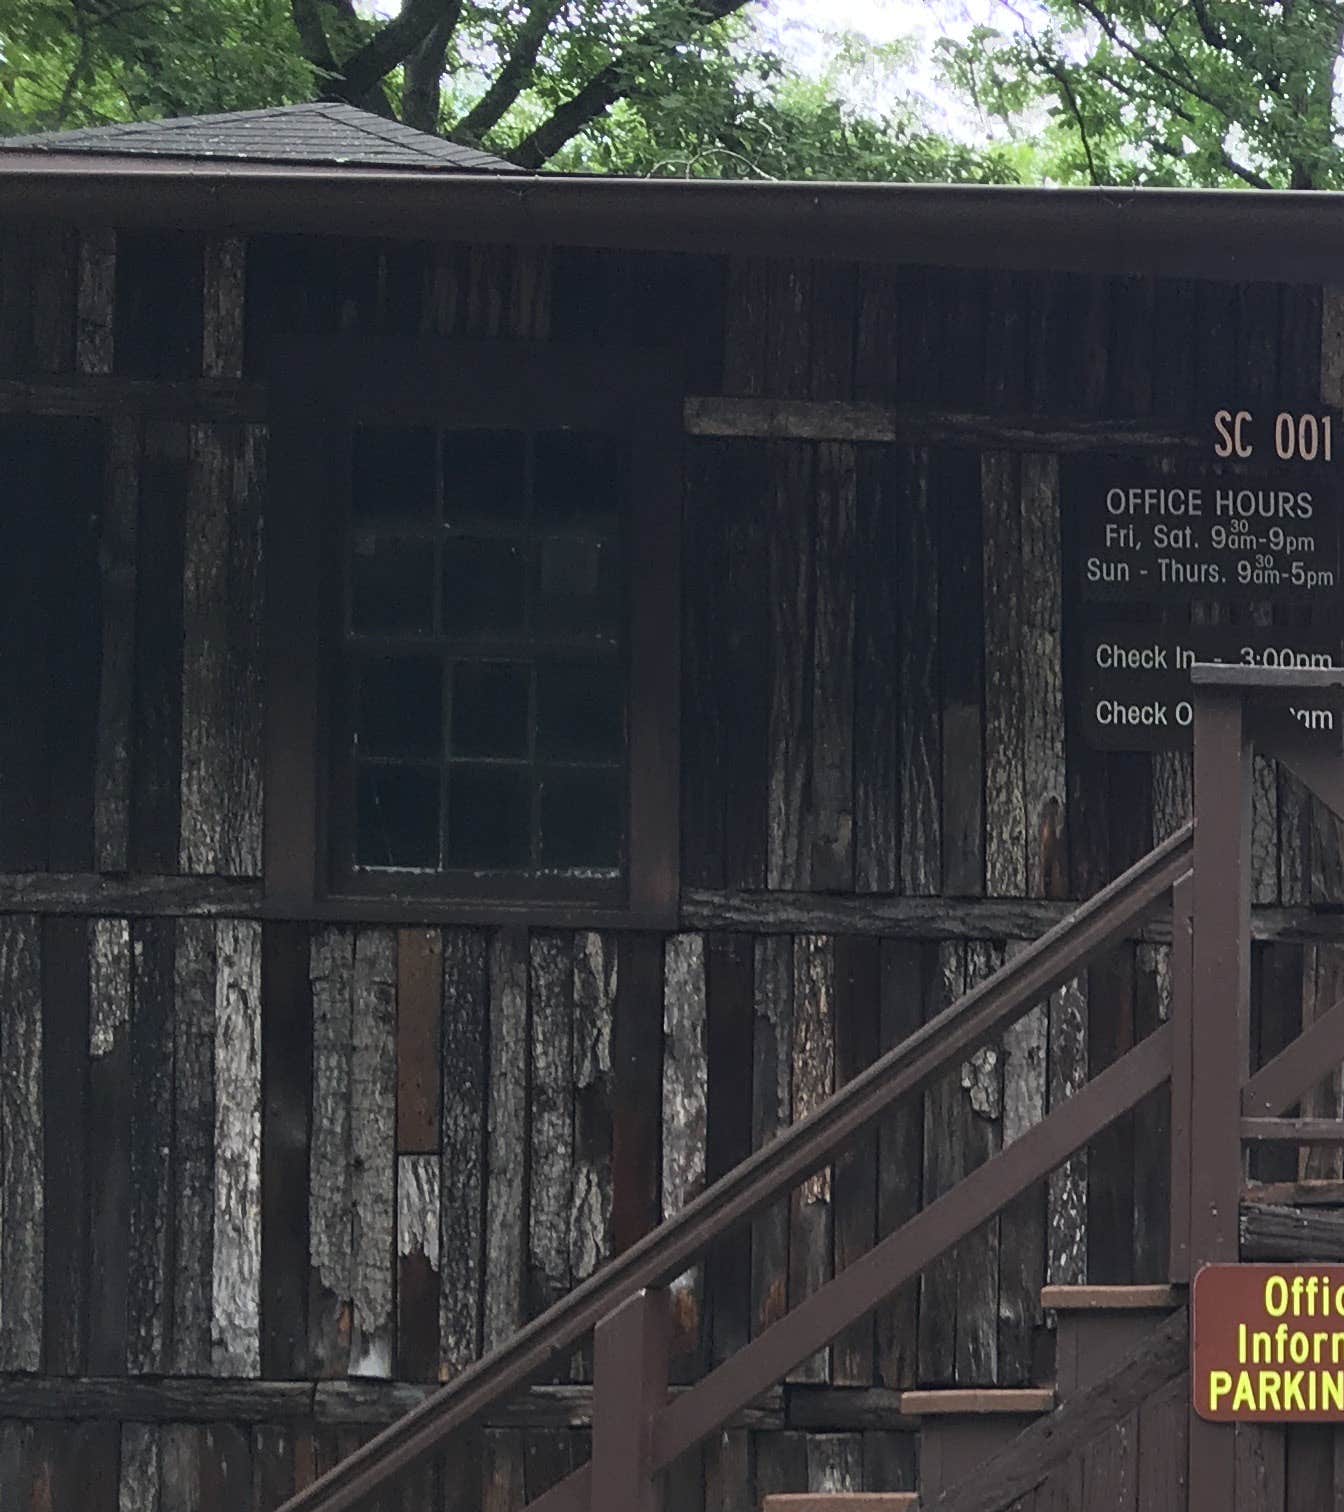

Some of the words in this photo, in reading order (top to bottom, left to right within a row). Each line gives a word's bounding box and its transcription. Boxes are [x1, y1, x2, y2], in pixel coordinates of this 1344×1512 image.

[1214, 410, 1253, 458] SC
[1275, 413, 1331, 461] 001
[1106, 488, 1202, 515] OFFICE
[1216, 490, 1313, 518] HOURS
[1105, 524, 1141, 550] Fri,
[1153, 525, 1199, 549] Sat.
[1087, 557, 1129, 581] Sun
[1158, 558, 1226, 583] Thurs.
[1096, 644, 1167, 669] Check
[1176, 646, 1196, 669] In
[1096, 701, 1167, 725] Check
